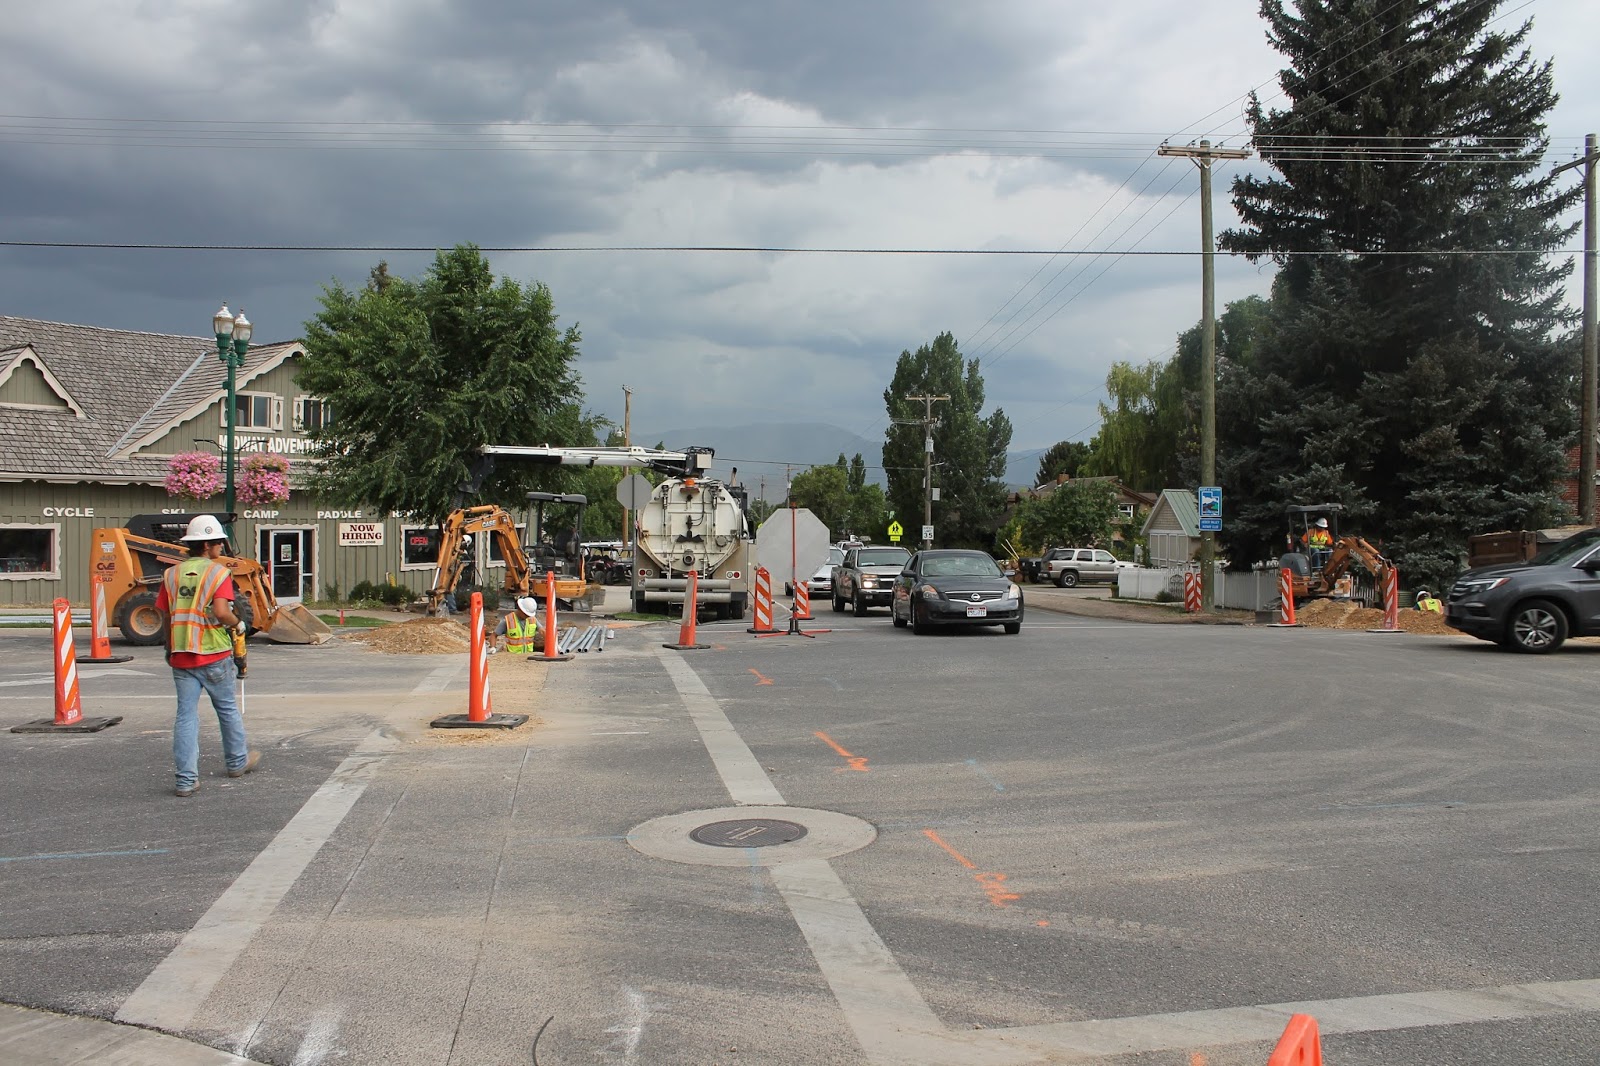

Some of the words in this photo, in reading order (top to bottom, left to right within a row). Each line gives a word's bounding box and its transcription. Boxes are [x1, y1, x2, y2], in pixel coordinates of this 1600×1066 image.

[218, 435, 265, 452] MDWAY
[43, 507, 94, 517] CYCLE
[243, 510, 279, 519] CAMP
[350, 524, 375, 532] NOW
[342, 532, 382, 540] HIRING
[97, 562, 115, 570] CVE
